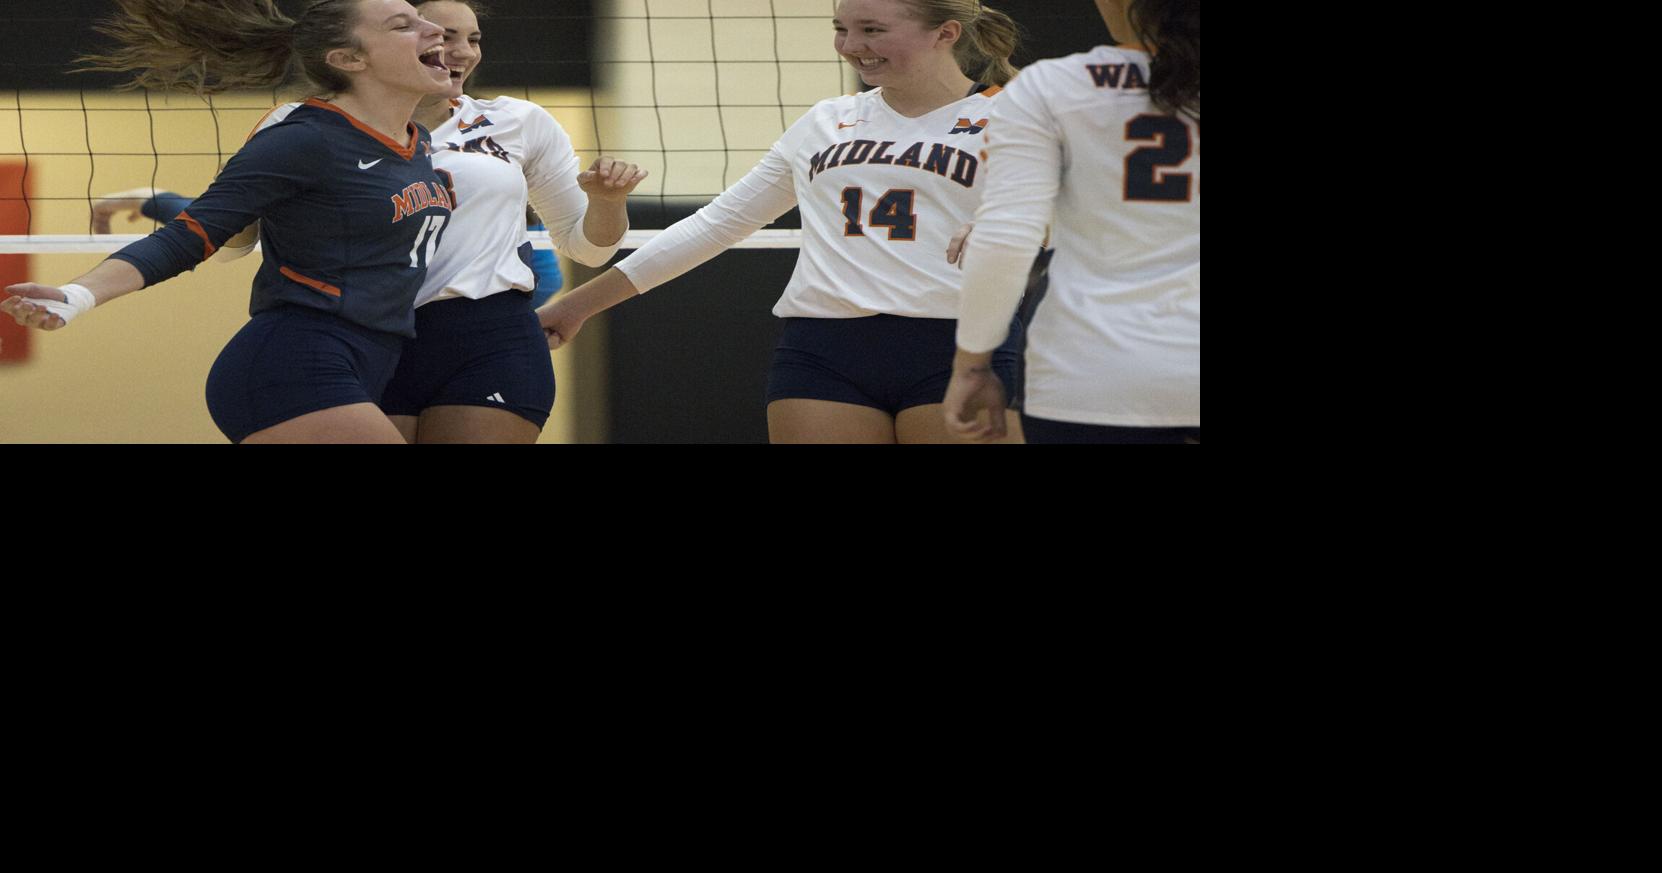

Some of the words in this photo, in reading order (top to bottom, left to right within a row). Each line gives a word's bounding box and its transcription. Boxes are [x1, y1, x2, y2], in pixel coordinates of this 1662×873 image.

[1085, 62, 1149, 88] WA
[808, 139, 979, 188] MIDLAND
[1122, 112, 1200, 203] 2
[840, 186, 917, 241] 14
[409, 215, 446, 268] 17
